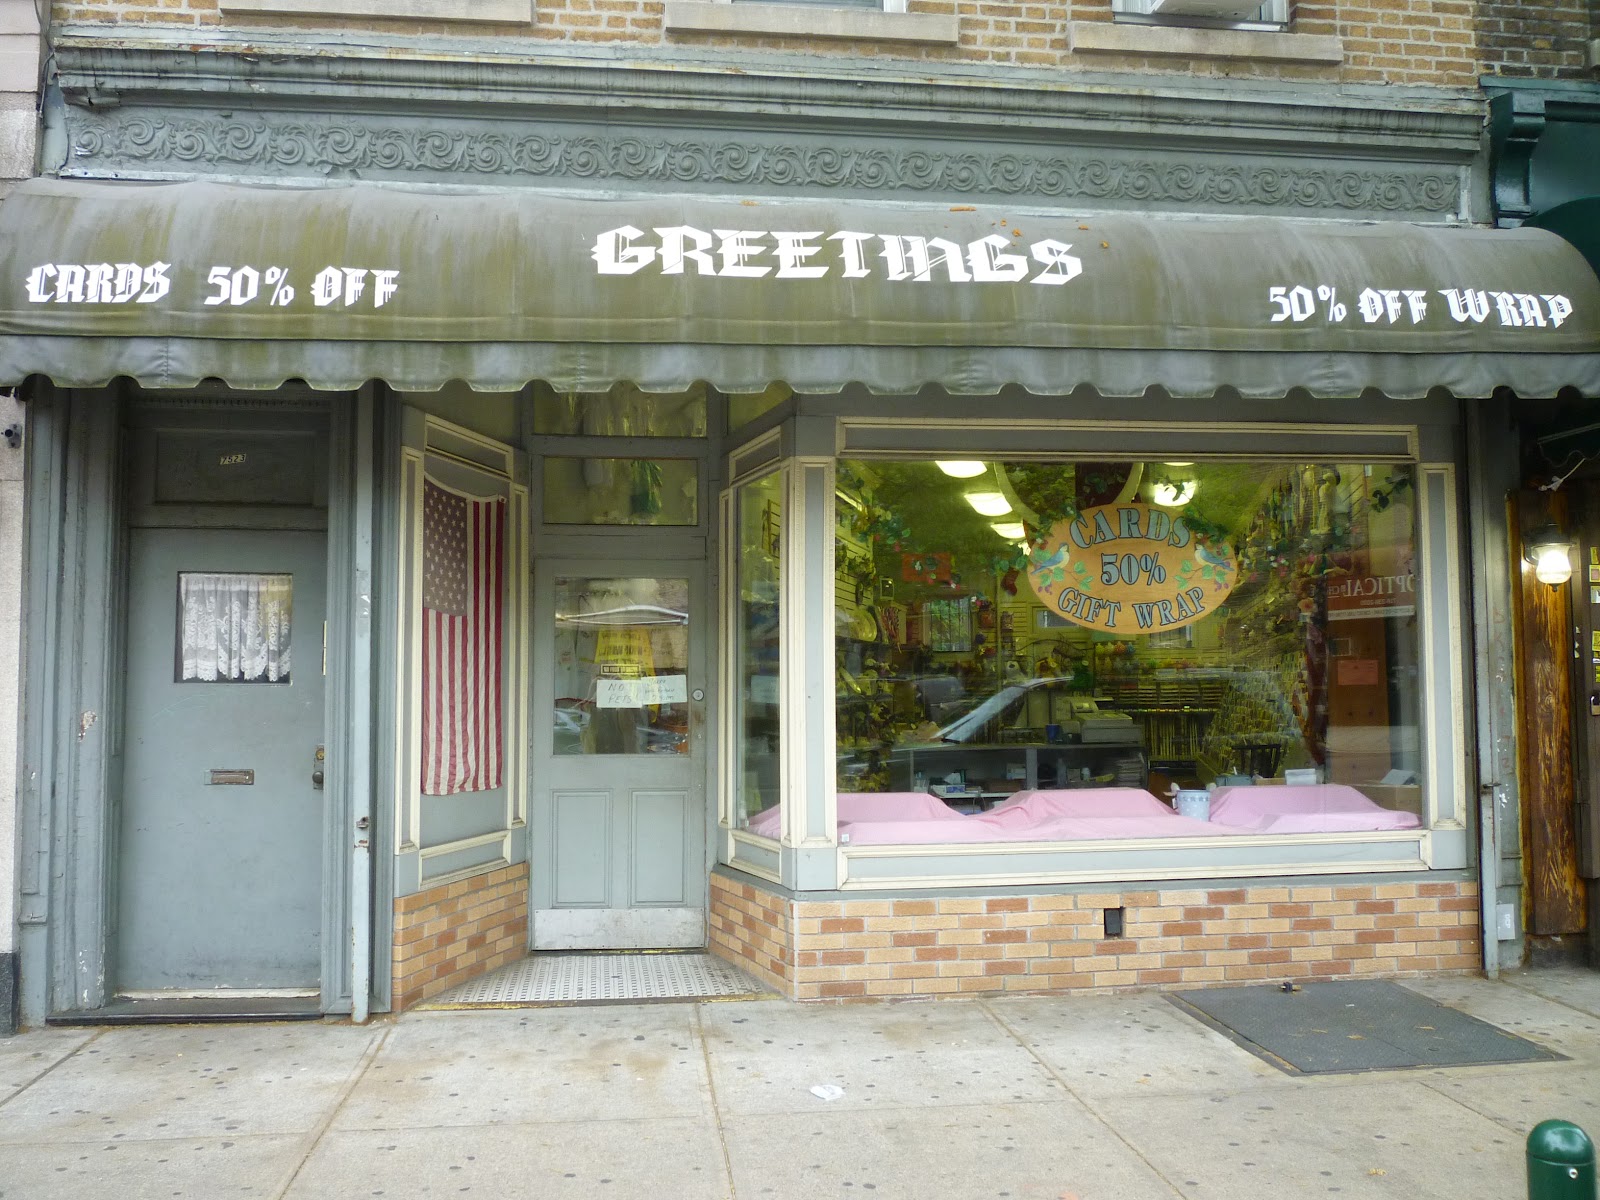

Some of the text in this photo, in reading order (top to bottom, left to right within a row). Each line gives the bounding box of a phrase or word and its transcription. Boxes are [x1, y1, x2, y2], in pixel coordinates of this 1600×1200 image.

[591, 224, 1083, 286] GREETINGS
[25, 260, 400, 308] CARDS 50% OFF
[1269, 284, 1574, 328] 50% OFF WRAP
[1069, 507, 1191, 549] CARDS
[1101, 552, 1167, 585] 50%
[1058, 587, 1205, 629] GIFT WRAP
